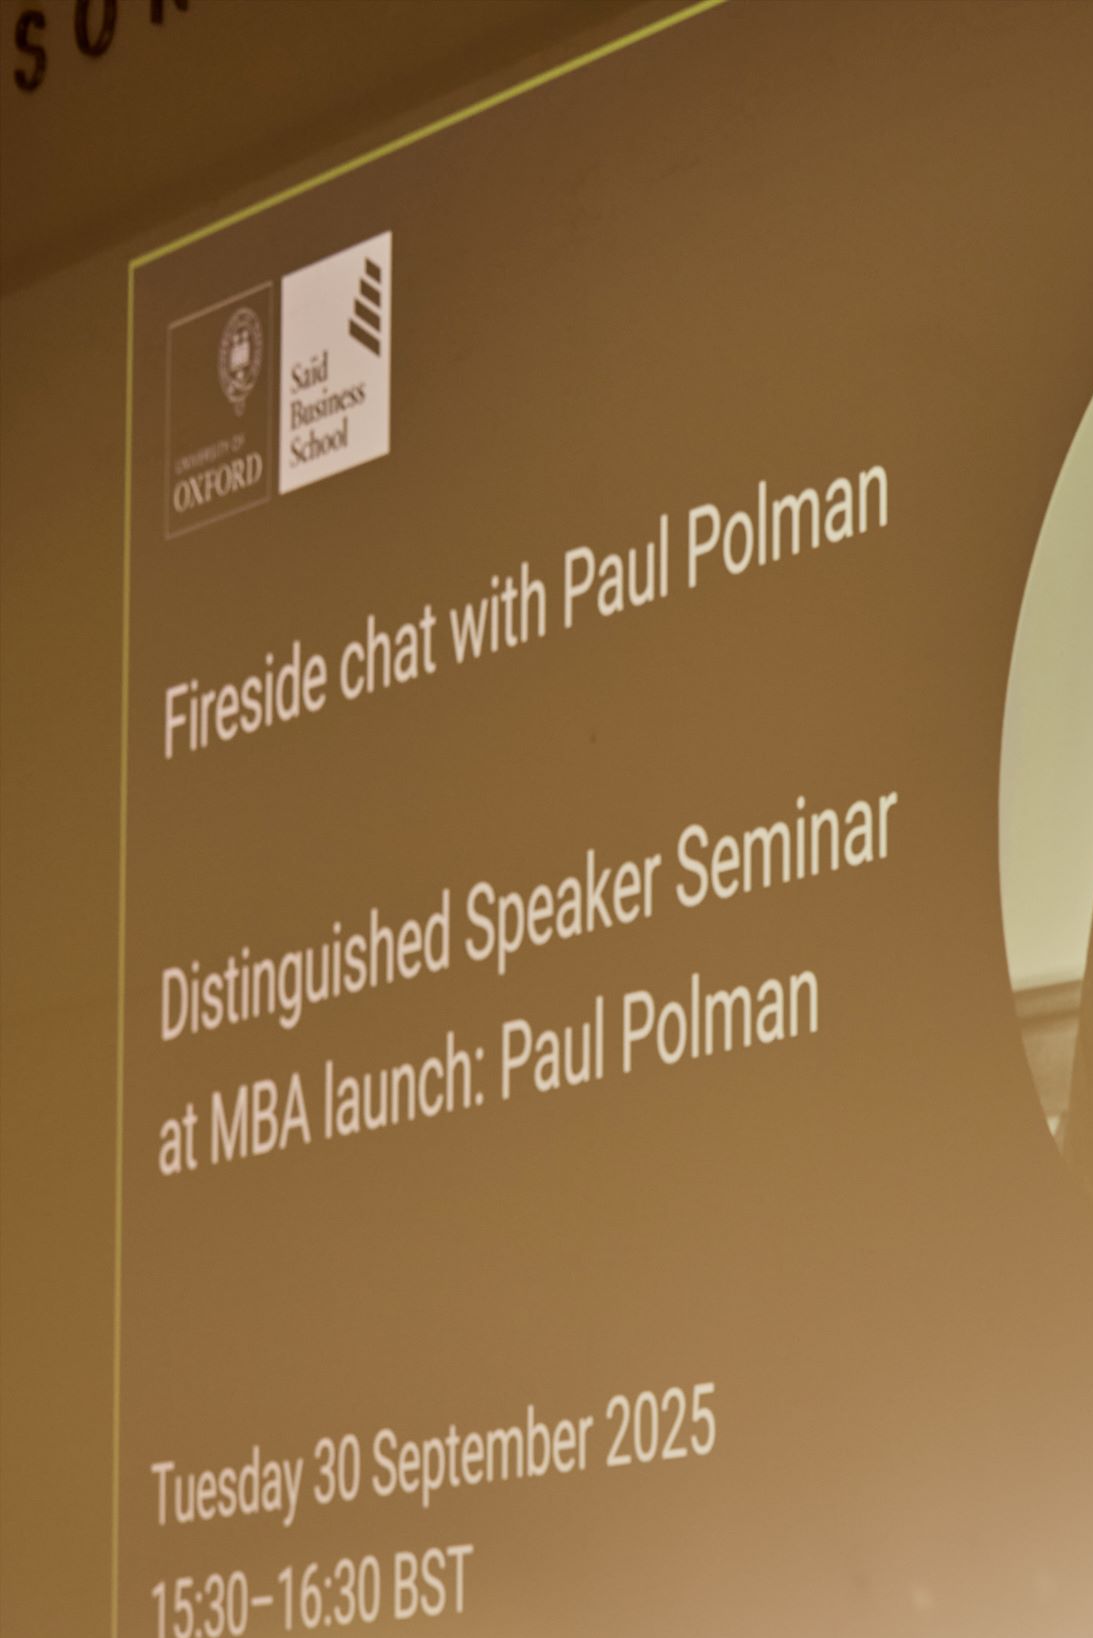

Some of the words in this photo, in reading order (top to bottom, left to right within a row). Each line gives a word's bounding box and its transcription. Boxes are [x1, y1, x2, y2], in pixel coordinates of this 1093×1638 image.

[14, 0, 188, 93] SO
[289, 416, 348, 469] School
[290, 382, 367, 430] Business
[173, 452, 263, 512] OXFORD
[164, 640, 327, 760] Fireside
[340, 604, 436, 700] chat
[450, 562, 547, 664] with
[563, 513, 669, 629] Paul
[688, 464, 889, 588] Polman
[161, 888, 451, 1042] Distinguished
[465, 848, 662, 975] Speaker
[676, 791, 898, 909] Seminar
[158, 1103, 199, 1176] at
[210, 1072, 312, 1165] MBA
[324, 1030, 486, 1140] launch:
[501, 994, 604, 1100] Paul
[622, 969, 820, 1074] Polman
[151, 1444, 304, 1528] Tuesday
[313, 1433, 361, 1506] 30
[372, 1403, 595, 1509] September
[606, 1382, 717, 1468] 2025
[393, 1543, 475, 1621] BST
